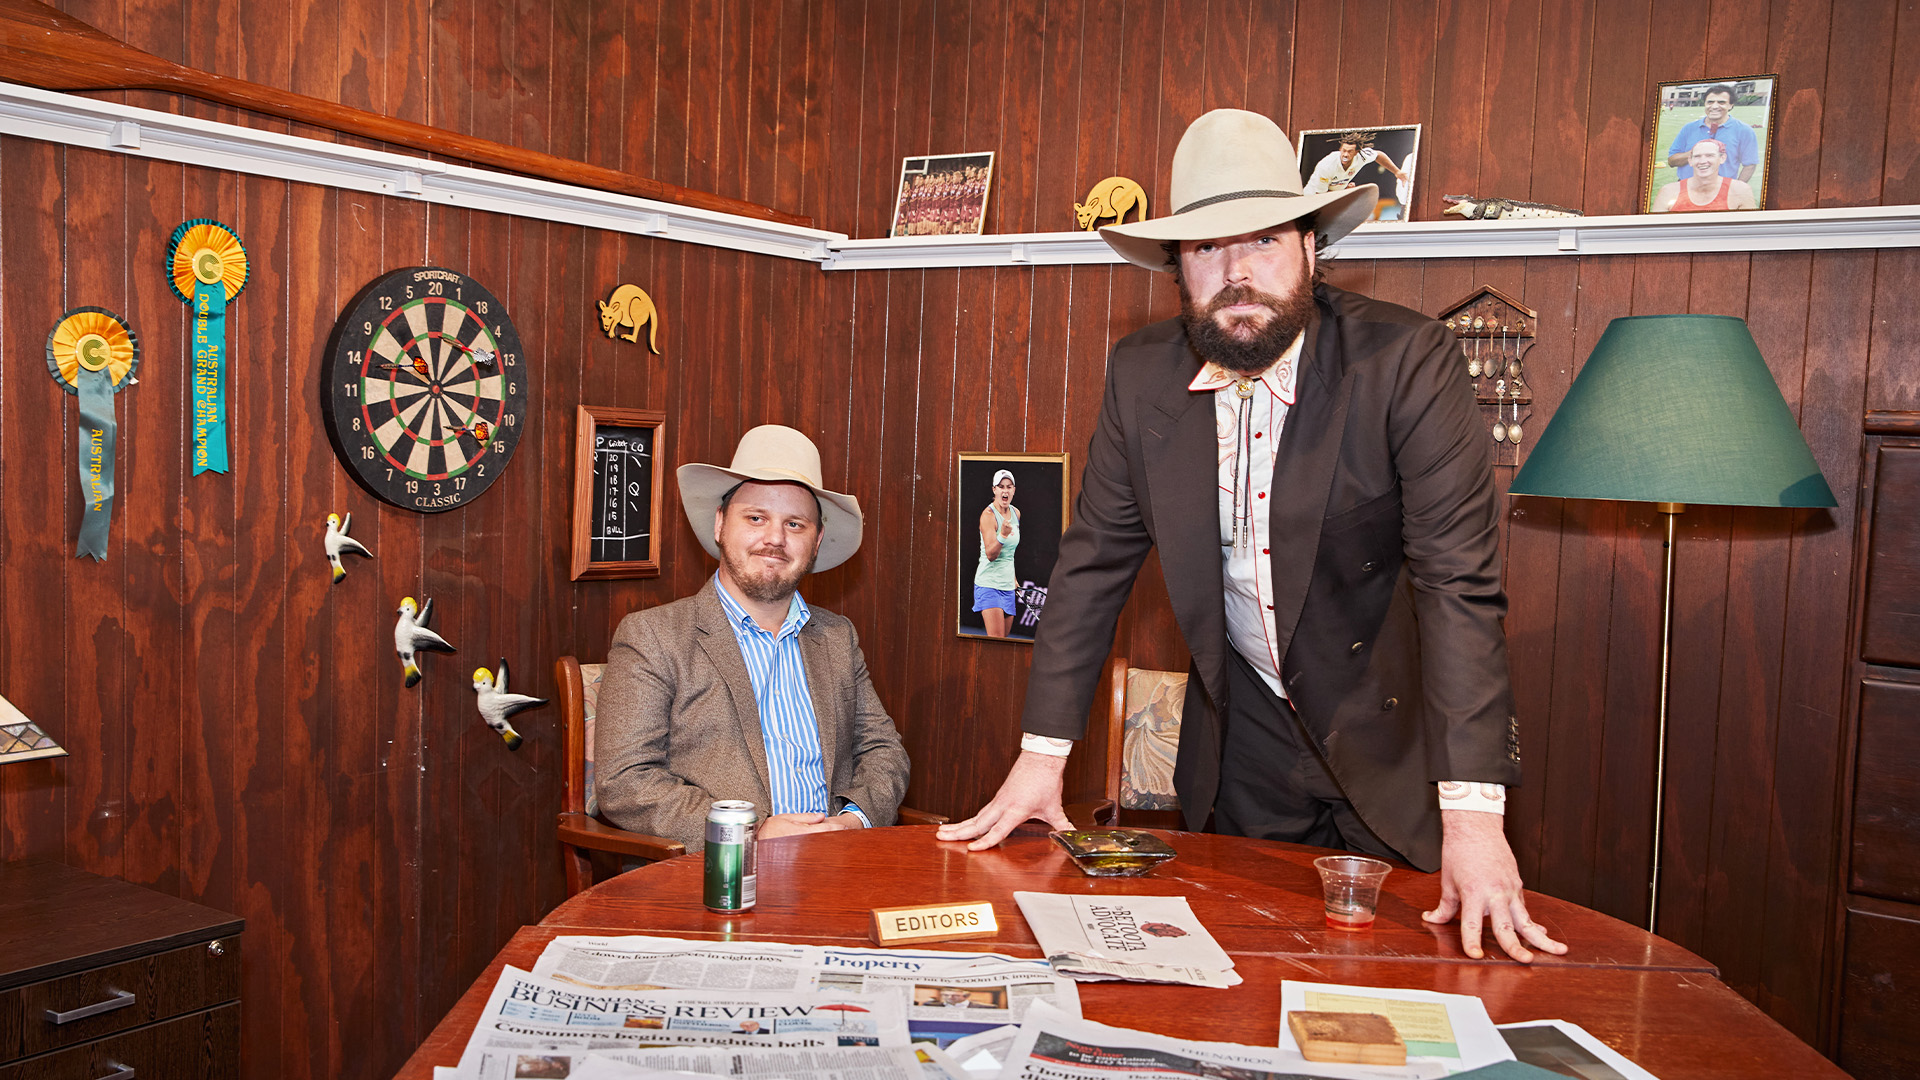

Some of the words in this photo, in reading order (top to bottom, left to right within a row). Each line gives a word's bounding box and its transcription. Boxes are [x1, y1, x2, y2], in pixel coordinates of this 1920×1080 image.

[413, 270, 460, 284] SPORTCRAFT
[406, 286, 414, 299] 5
[428, 282, 443, 296] 20
[456, 288, 461, 300] 1
[379, 296, 393, 310] 12
[476, 301, 488, 314] 18
[197, 293, 209, 344] DOUBLE
[364, 322, 372, 335] 9
[494, 325, 502, 338] 4
[348, 351, 362, 365] 14
[503, 354, 516, 367] 13
[197, 349, 207, 396] GRAND
[207, 344, 218, 423] AUSTRALIAN
[344, 383, 358, 397] 11
[509, 382, 516, 395] 6
[352, 417, 360, 431] 8
[503, 414, 515, 427] 10
[197, 397, 208, 468] CHAMPION
[361, 446, 374, 459] 16
[493, 440, 505, 453] 15
[608, 453, 619, 462] 20
[91, 428, 103, 512] AUSTRALIAN
[477, 464, 485, 477] 2
[610, 464, 619, 473] 19
[386, 469, 393, 482] 7
[609, 475, 618, 485] 18
[405, 481, 419, 493] 19
[433, 483, 441, 495] 3
[454, 478, 466, 490] 17
[415, 493, 461, 507] CLASSIC
[609, 498, 618, 508] 16
[895, 911, 980, 933] EDITORS
[1089, 904, 1127, 951] ADVOCATE
[1112, 910, 1147, 951] BETOOTA
[591, 951, 631, 959] downs
[755, 955, 782, 963] days
[824, 956, 924, 972] Property
[514, 979, 545, 993] THE
[547, 989, 648, 1004] AUSTRALIAN
[510, 986, 667, 1014] BUSINESS
[675, 1005, 815, 1019] REVIEW
[494, 1022, 609, 1039] Consumers
[615, 1032, 671, 1043] begin
[702, 1036, 772, 1047] tighten
[778, 1039, 825, 1048] belts
[1180, 1046, 1210, 1058] THE
[1211, 1051, 1273, 1065] NATION
